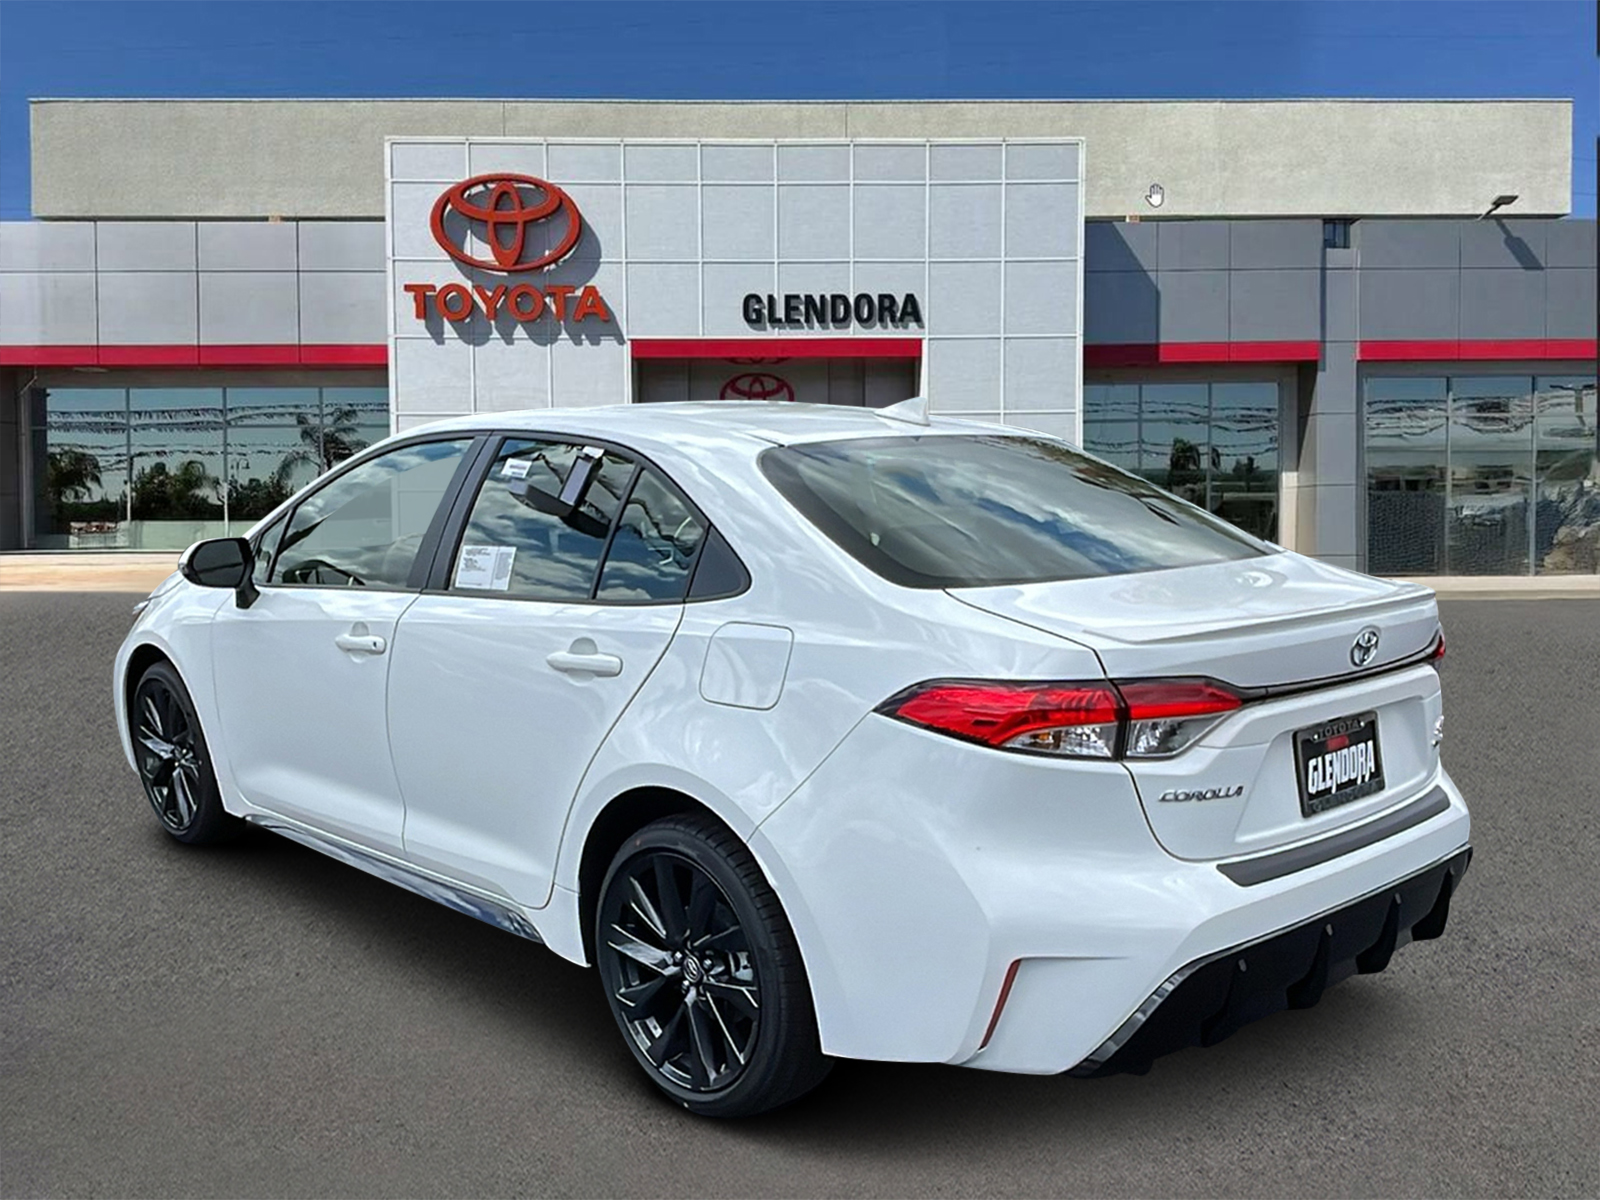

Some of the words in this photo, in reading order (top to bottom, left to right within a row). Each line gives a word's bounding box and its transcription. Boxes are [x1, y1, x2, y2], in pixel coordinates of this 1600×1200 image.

[404, 283, 609, 321] TOYOTA
[743, 293, 922, 324] GLENDORA
[1318, 719, 1361, 738] TOYOTA
[1307, 739, 1375, 795] GLENDORA
[1158, 785, 1244, 802] COROLLA
